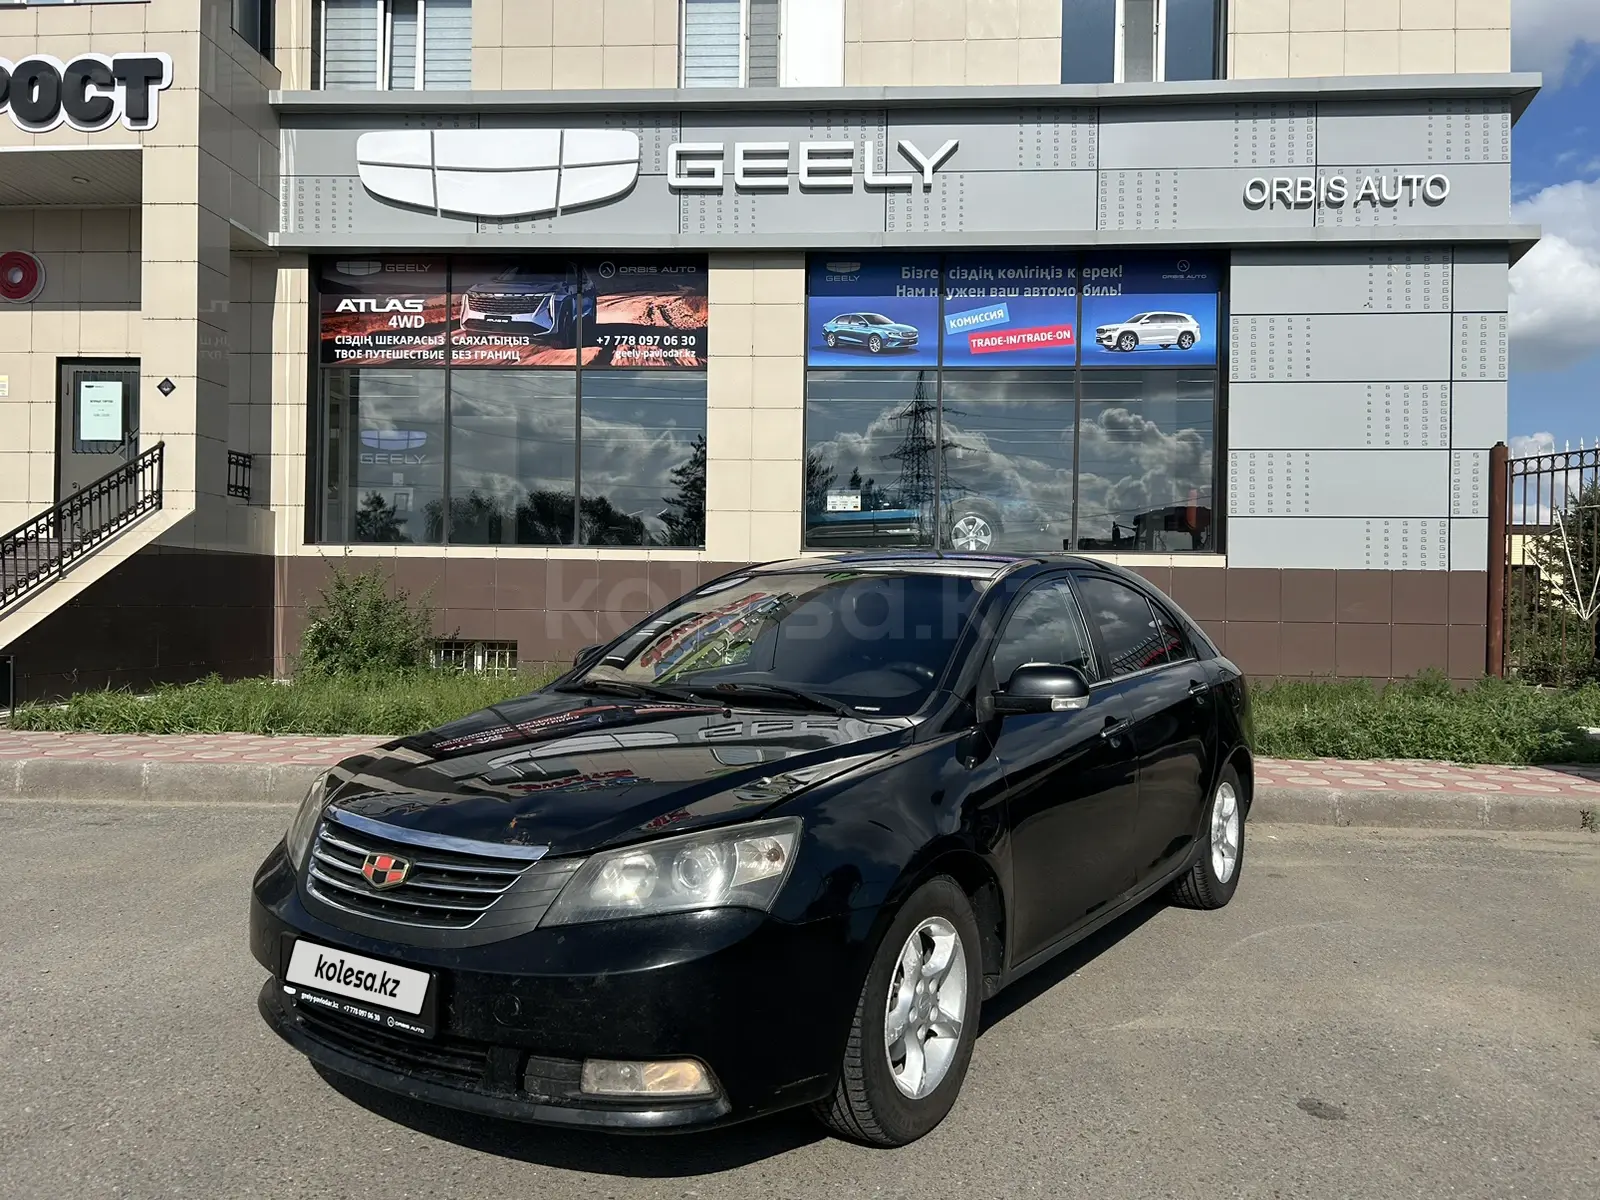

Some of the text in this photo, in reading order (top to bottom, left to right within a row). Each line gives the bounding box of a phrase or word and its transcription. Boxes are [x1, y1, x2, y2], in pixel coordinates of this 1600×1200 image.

[0, 57, 164, 124] ОСТ
[667, 139, 960, 191] GEELY
[1243, 173, 1451, 209] ORBIS AUTO
[385, 263, 432, 273] GEELY
[619, 266, 658, 274] ORBIS
[901, 266, 938, 279] Бізге
[949, 266, 993, 281] сіздің
[998, 266, 1062, 281] көлігіңіз
[896, 285, 925, 297] Нам
[990, 287, 1019, 297] ваш
[335, 298, 425, 313] ATLAS
[388, 315, 425, 329] 4WD
[950, 309, 1005, 329] КОМИССИЯ
[335, 335, 530, 347] СІЗДІҢ ШЕКАРАСЫЗ САЯХАТЫҢЫЗ
[597, 336, 696, 346] +7 778 097 06 30
[971, 329, 1071, 348] TRADE-IN/TRADE-ON
[335, 350, 520, 361] ТВОЕ ПУТЕШЕСТВИЕ БЕЗ ГРАНИЦ
[615, 348, 696, 359] geely-pavlodar.kz
[360, 453, 426, 464] GEELY
